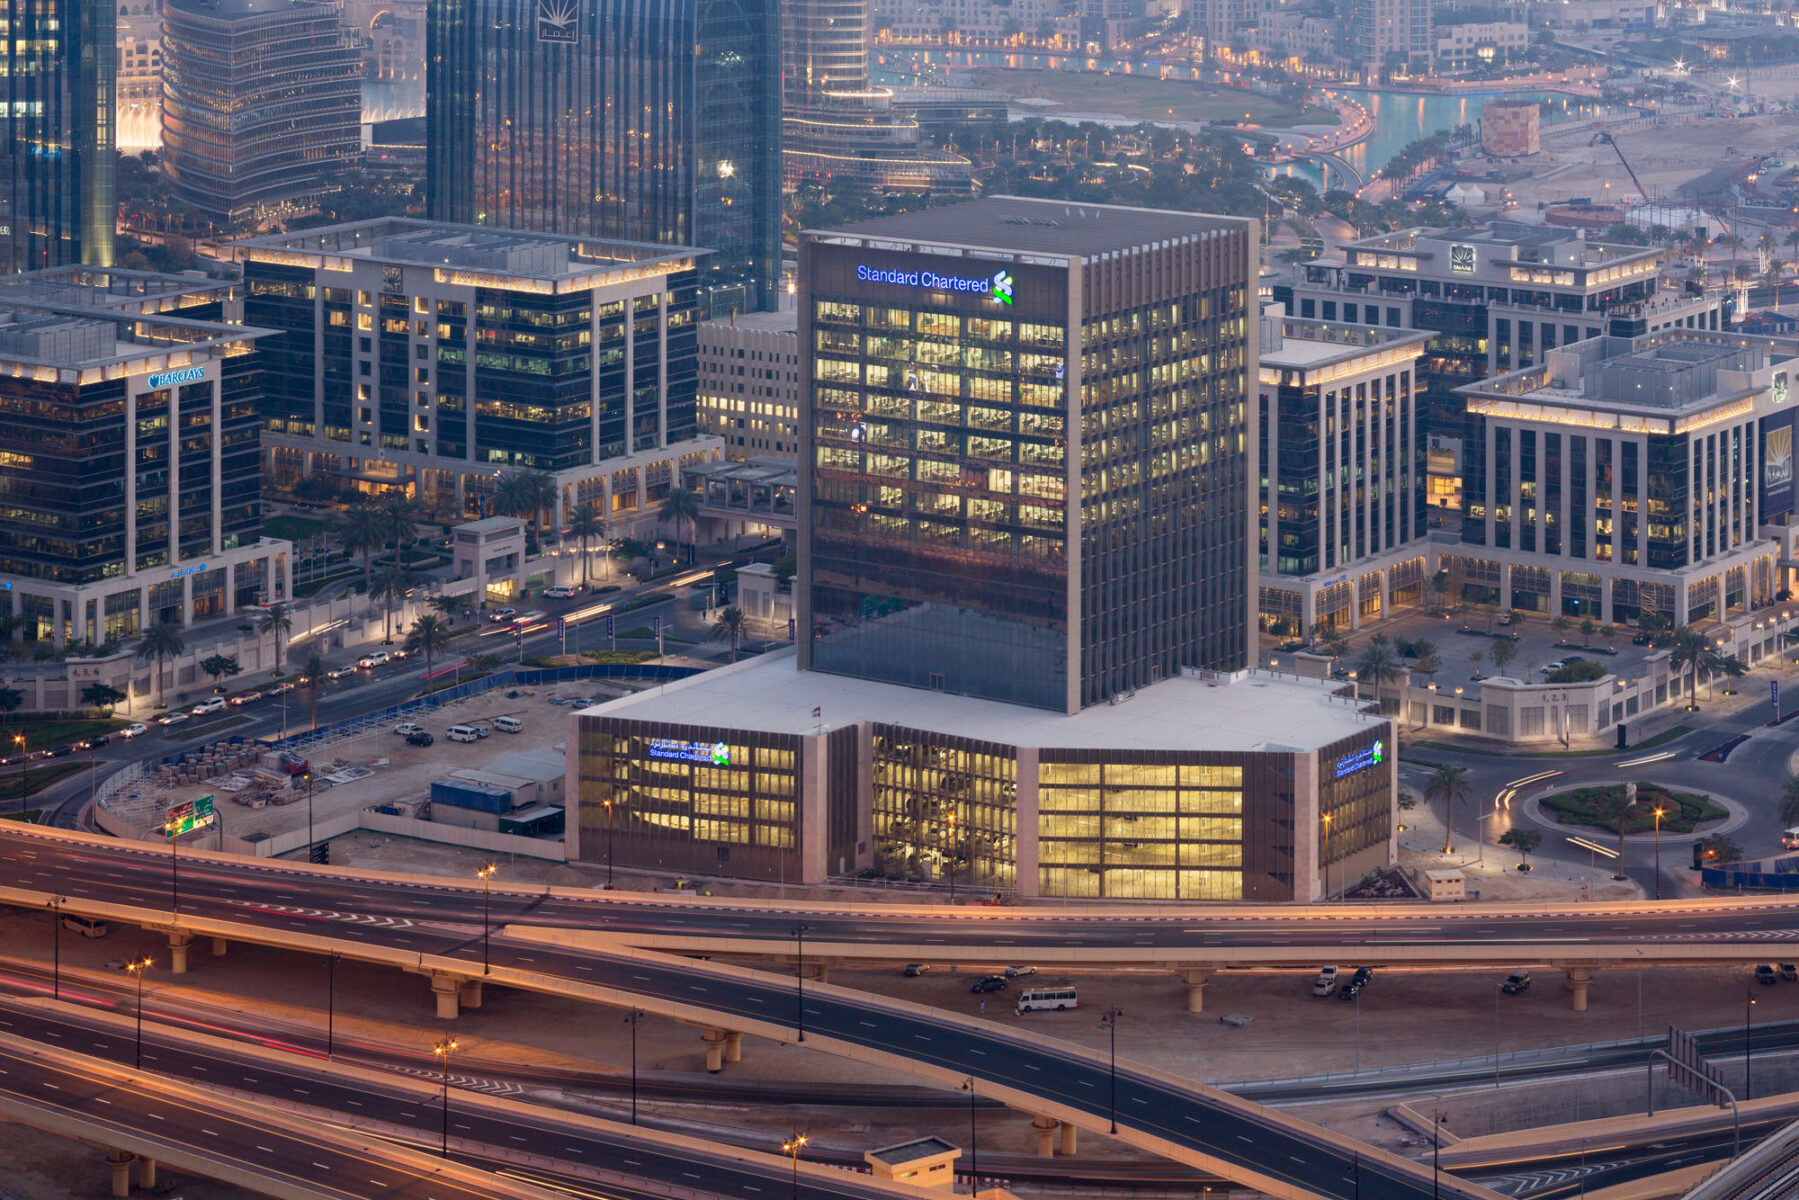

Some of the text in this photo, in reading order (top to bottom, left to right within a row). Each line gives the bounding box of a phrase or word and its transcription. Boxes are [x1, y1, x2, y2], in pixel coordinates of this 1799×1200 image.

[857, 264, 989, 293] Standard Chartered
[158, 366, 205, 386] BARCLAYS
[650, 748, 712, 762] Standard Chartered
